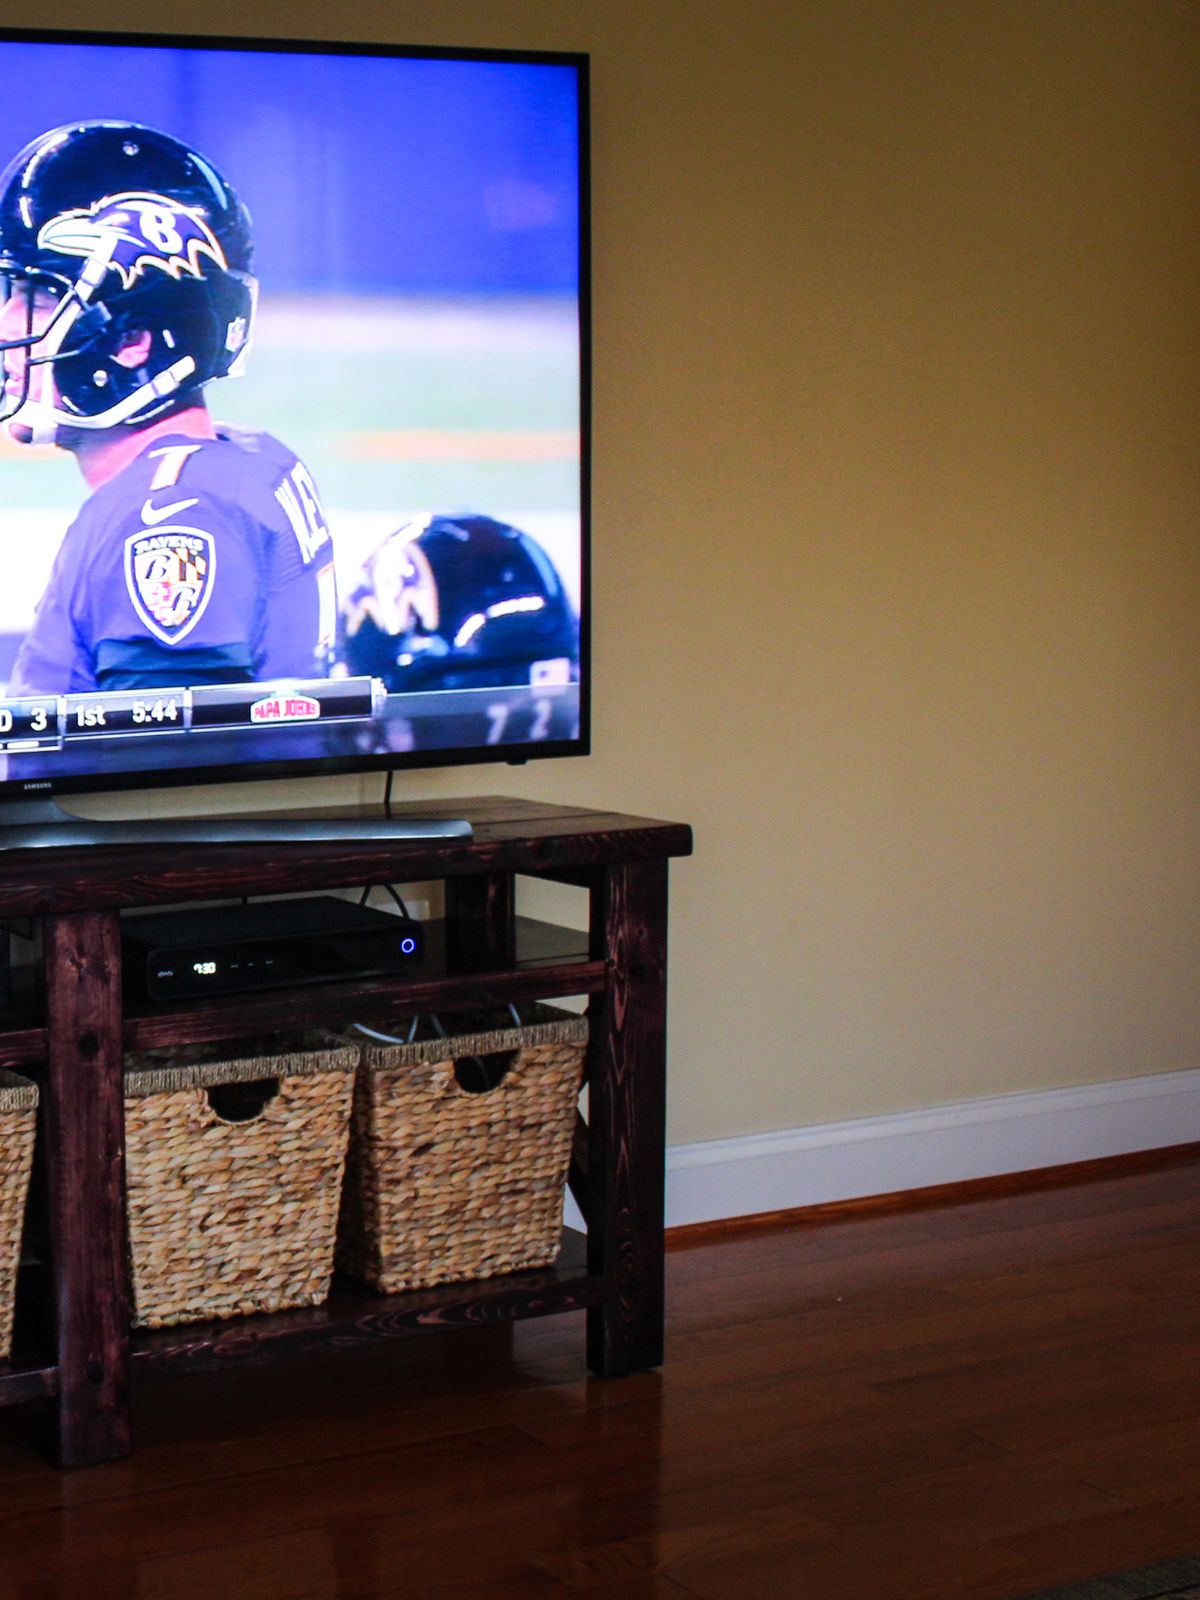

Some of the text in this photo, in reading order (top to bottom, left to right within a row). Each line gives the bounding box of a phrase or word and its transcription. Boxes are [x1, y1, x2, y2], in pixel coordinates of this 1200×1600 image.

[149, 444, 203, 491] 7
[133, 535, 205, 556] RAVENS
[31, 706, 47, 731] 3
[75, 704, 107, 727] 1st
[132, 698, 178, 723] 5:44
[23, 782, 53, 790] SAMSUNG
